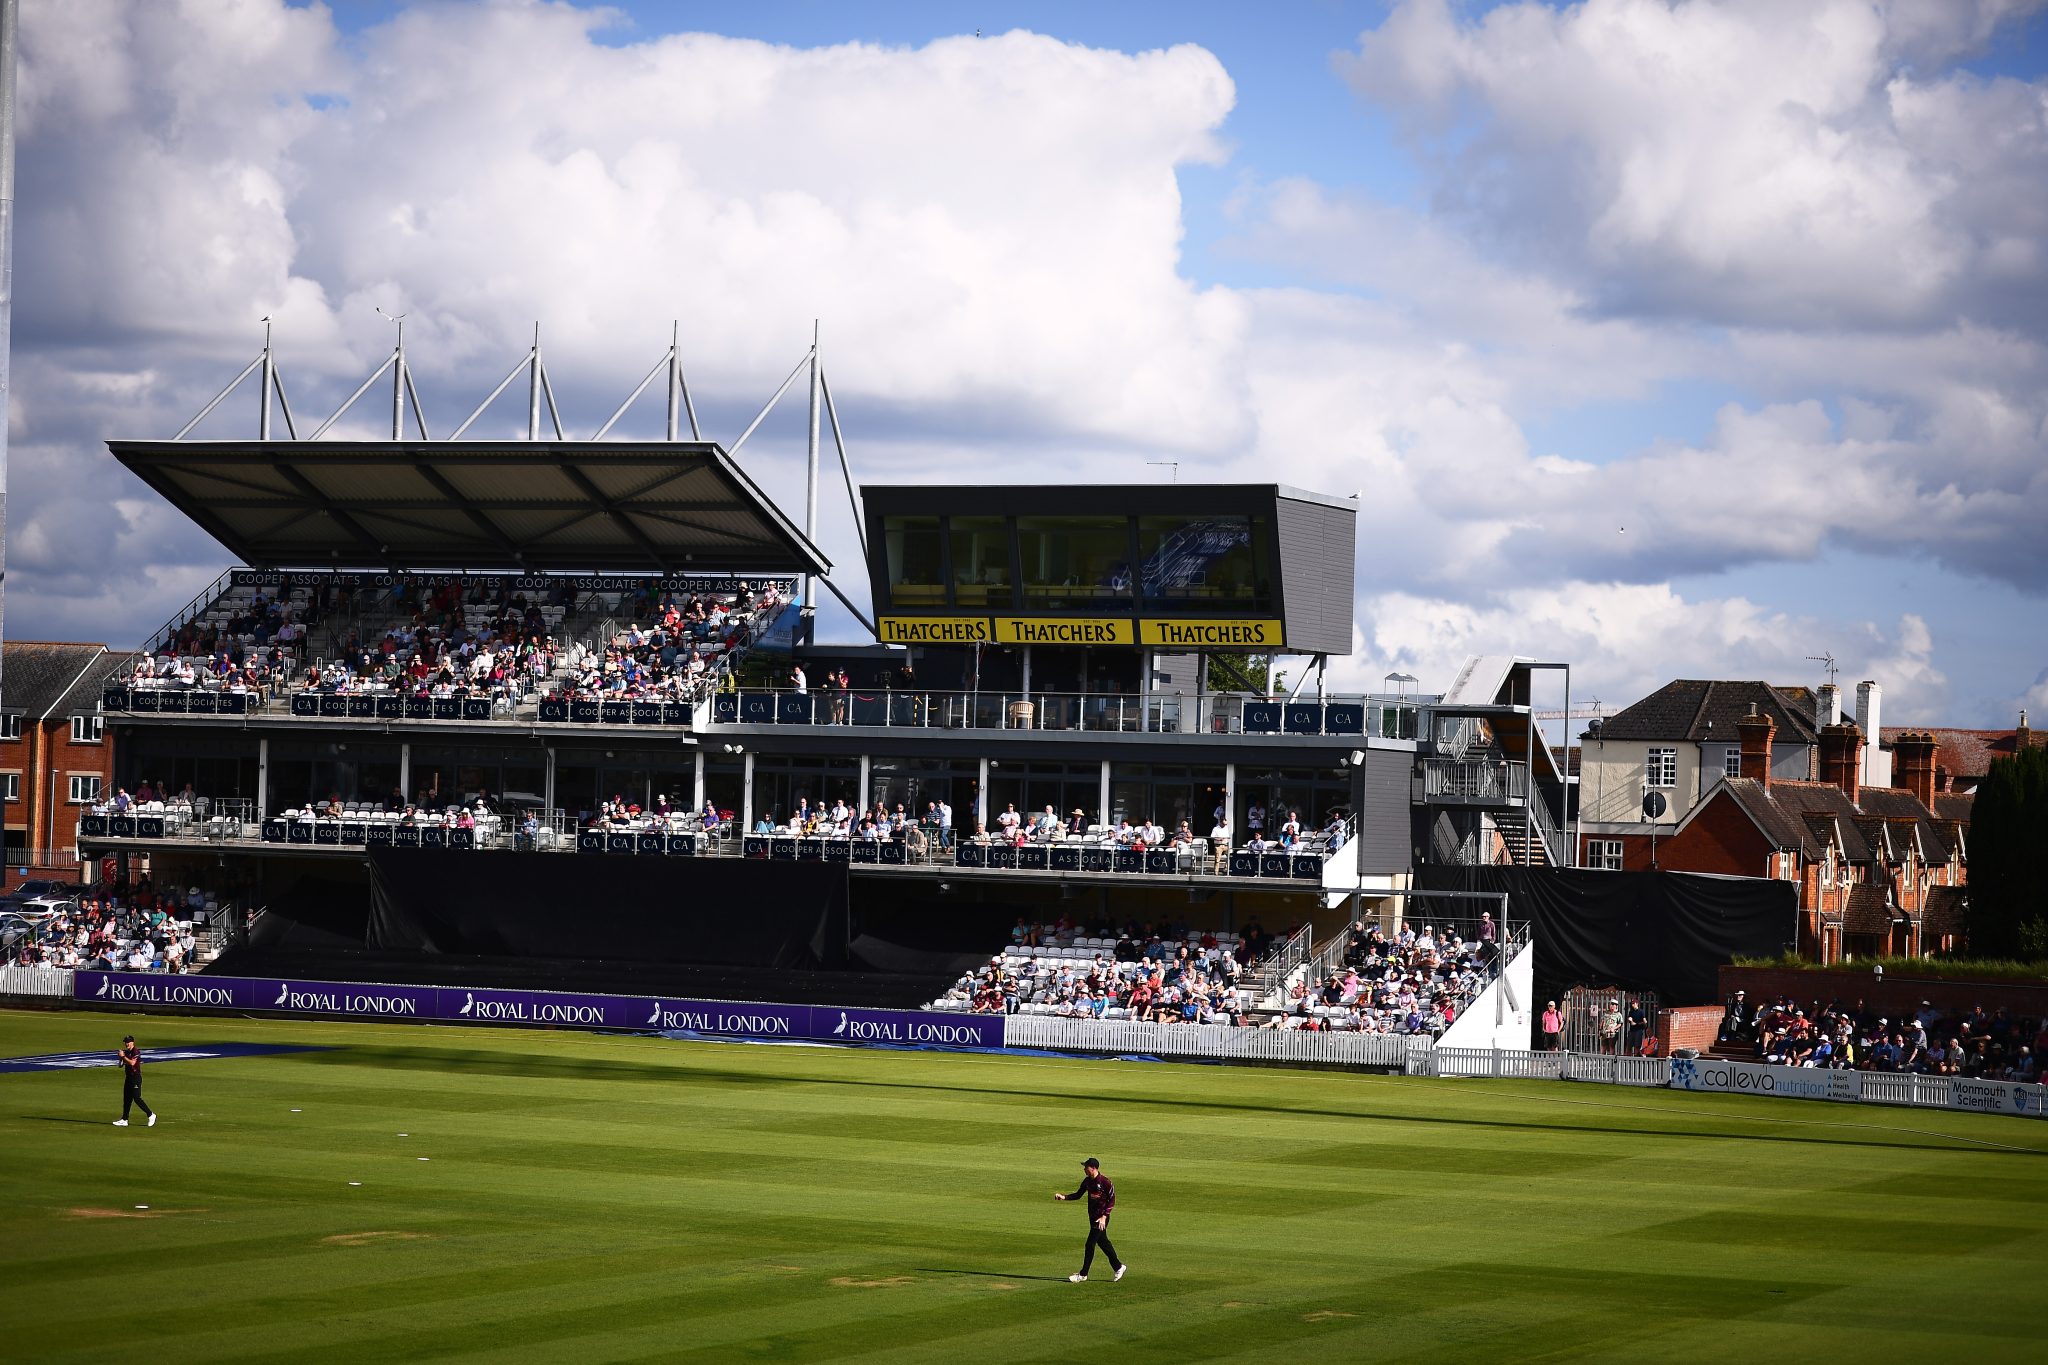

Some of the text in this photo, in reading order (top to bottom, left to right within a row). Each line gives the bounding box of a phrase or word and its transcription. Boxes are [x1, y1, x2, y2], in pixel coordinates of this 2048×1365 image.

[516, 577, 566, 588] COOPR
[660, 580, 791, 592] COOPER ASSCIAES
[884, 620, 986, 640] THATCHERS
[1011, 621, 1116, 642] THATCHERS
[1157, 623, 1265, 643] THATCHERS
[109, 696, 123, 706] CA
[177, 699, 232, 707] ASSOCIATES
[298, 700, 312, 710] CA
[325, 702, 454, 713] COOPER ASSOCIATES
[469, 704, 484, 714] CA
[546, 706, 561, 716] CA
[719, 702, 735, 712] CA
[750, 702, 766, 713] CA
[787, 703, 802, 713] CA
[579, 707, 680, 718] COOPER ASSOCIATES
[1253, 712, 1270, 723] CA
[1294, 713, 1311, 723] CA
[1335, 713, 1351, 724] CA
[86, 821, 101, 831] CA
[114, 822, 129, 832] CA
[142, 823, 157, 833] CA
[266, 827, 281, 837] CA
[292, 828, 307, 838] CA
[319, 830, 417, 841] COOPER ASSOCIATES
[426, 832, 441, 842] CA
[453, 833, 468, 843] CA
[583, 838, 599, 848] CA
[613, 838, 629, 848] CA
[643, 839, 659, 849] CA
[673, 840, 689, 850] CA
[748, 843, 763, 853] CA
[775, 845, 876, 856] COOPER ASSOCIATES
[884, 848, 900, 858] CA
[962, 850, 978, 861] CA
[993, 852, 1135, 865] COOPER ASSOCIATES
[1152, 857, 1168, 867] CA
[1235, 859, 1252, 870] CA
[1266, 860, 1283, 871] CA
[1298, 861, 1315, 872] CA
[111, 984, 233, 1005] ROYAL LONDON
[290, 992, 416, 1014] ROYAL LONDON
[476, 1001, 604, 1023] ROYAL LONDON
[663, 1011, 790, 1034] ROYAL LONDON
[850, 1021, 982, 1044] ROYAL LONDON
[1704, 1067, 1825, 1095] calleva nutrition
[1833, 1074, 1848, 1083] Sport
[1833, 1083, 1850, 1091] Health
[1952, 1082, 2006, 1098] Monmouth
[1832, 1092, 1859, 1101] Wellbeing
[1957, 1094, 2001, 1109] Scientific
